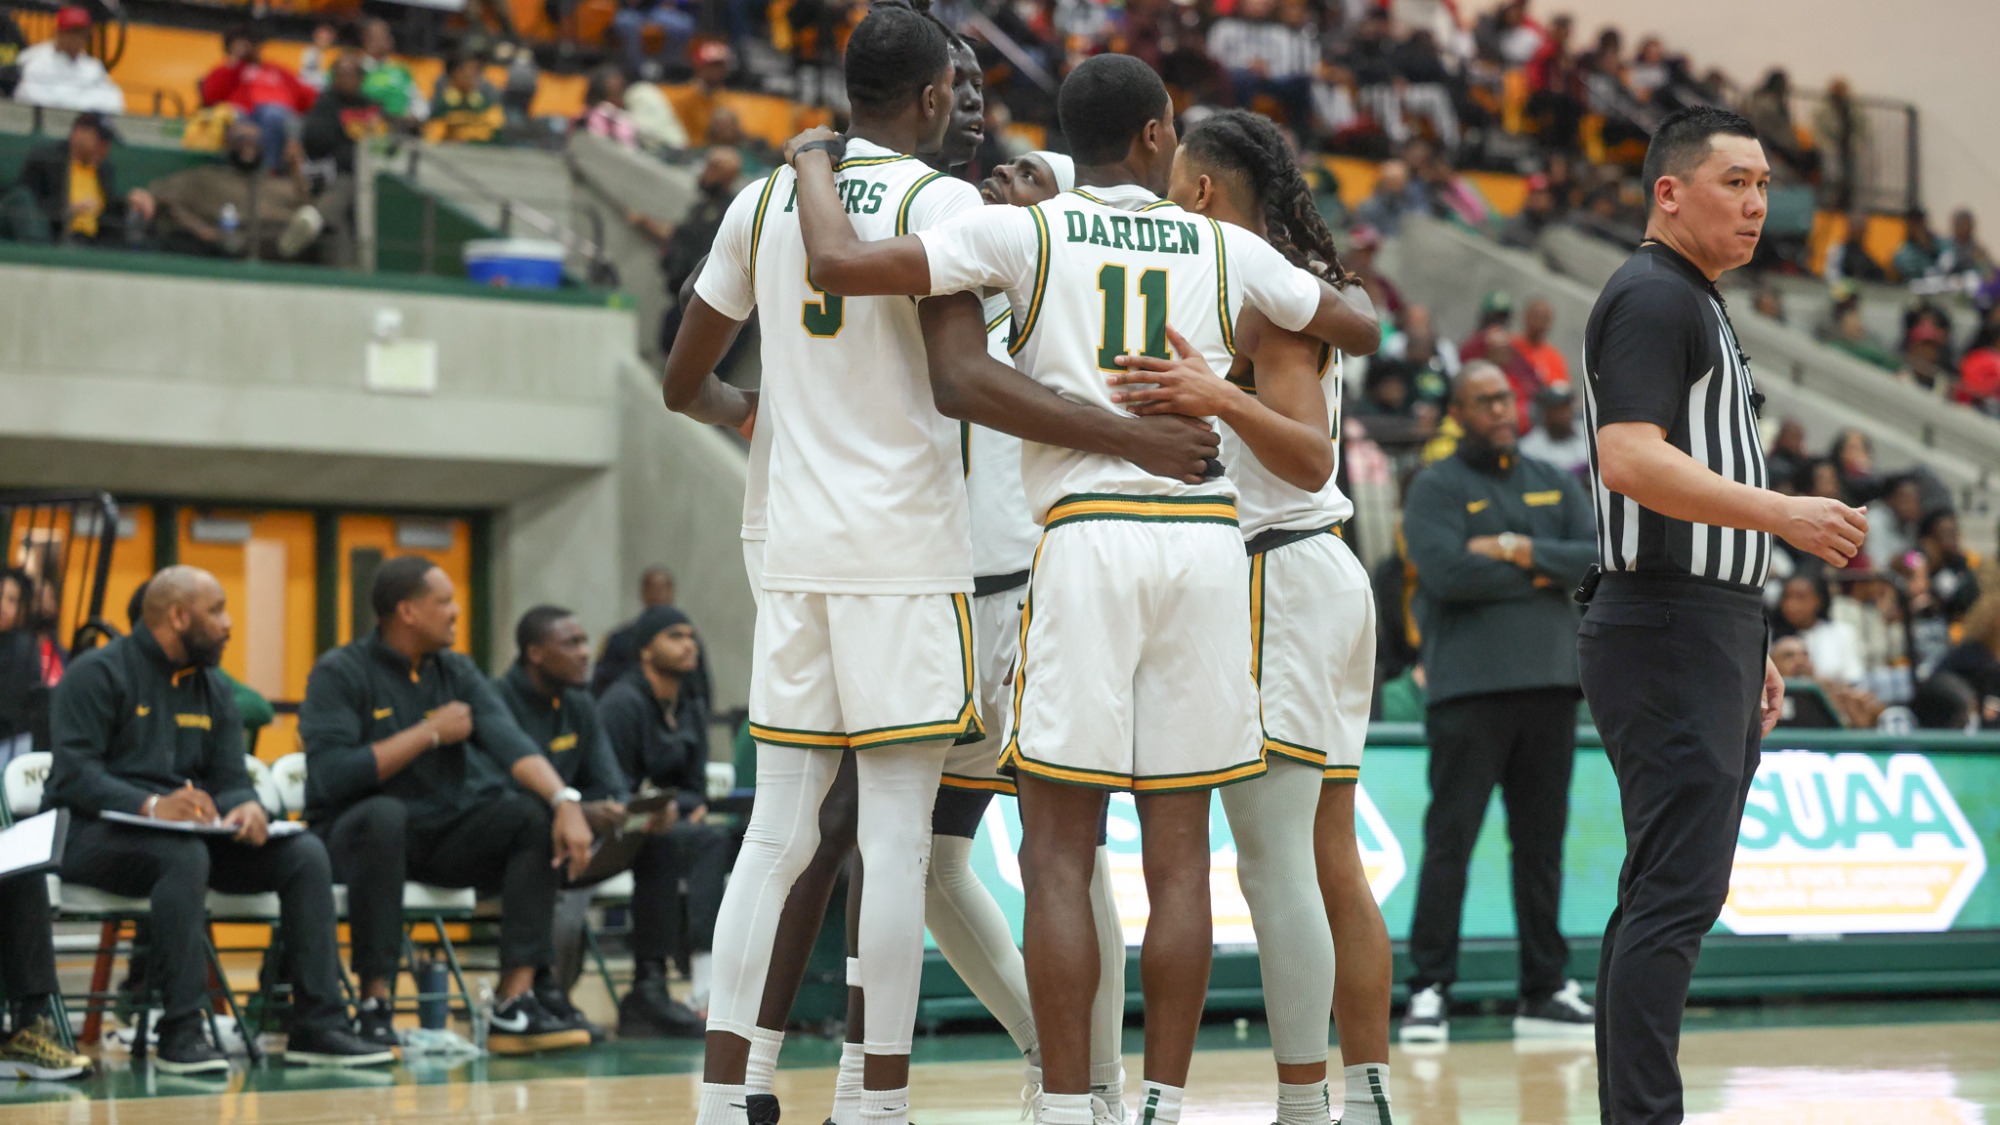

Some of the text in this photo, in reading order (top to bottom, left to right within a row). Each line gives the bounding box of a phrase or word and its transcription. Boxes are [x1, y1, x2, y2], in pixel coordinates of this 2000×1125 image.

[784, 178, 888, 215] ERS
[1064, 210, 1199, 255] DARDEN
[1096, 261, 1173, 373] 11
